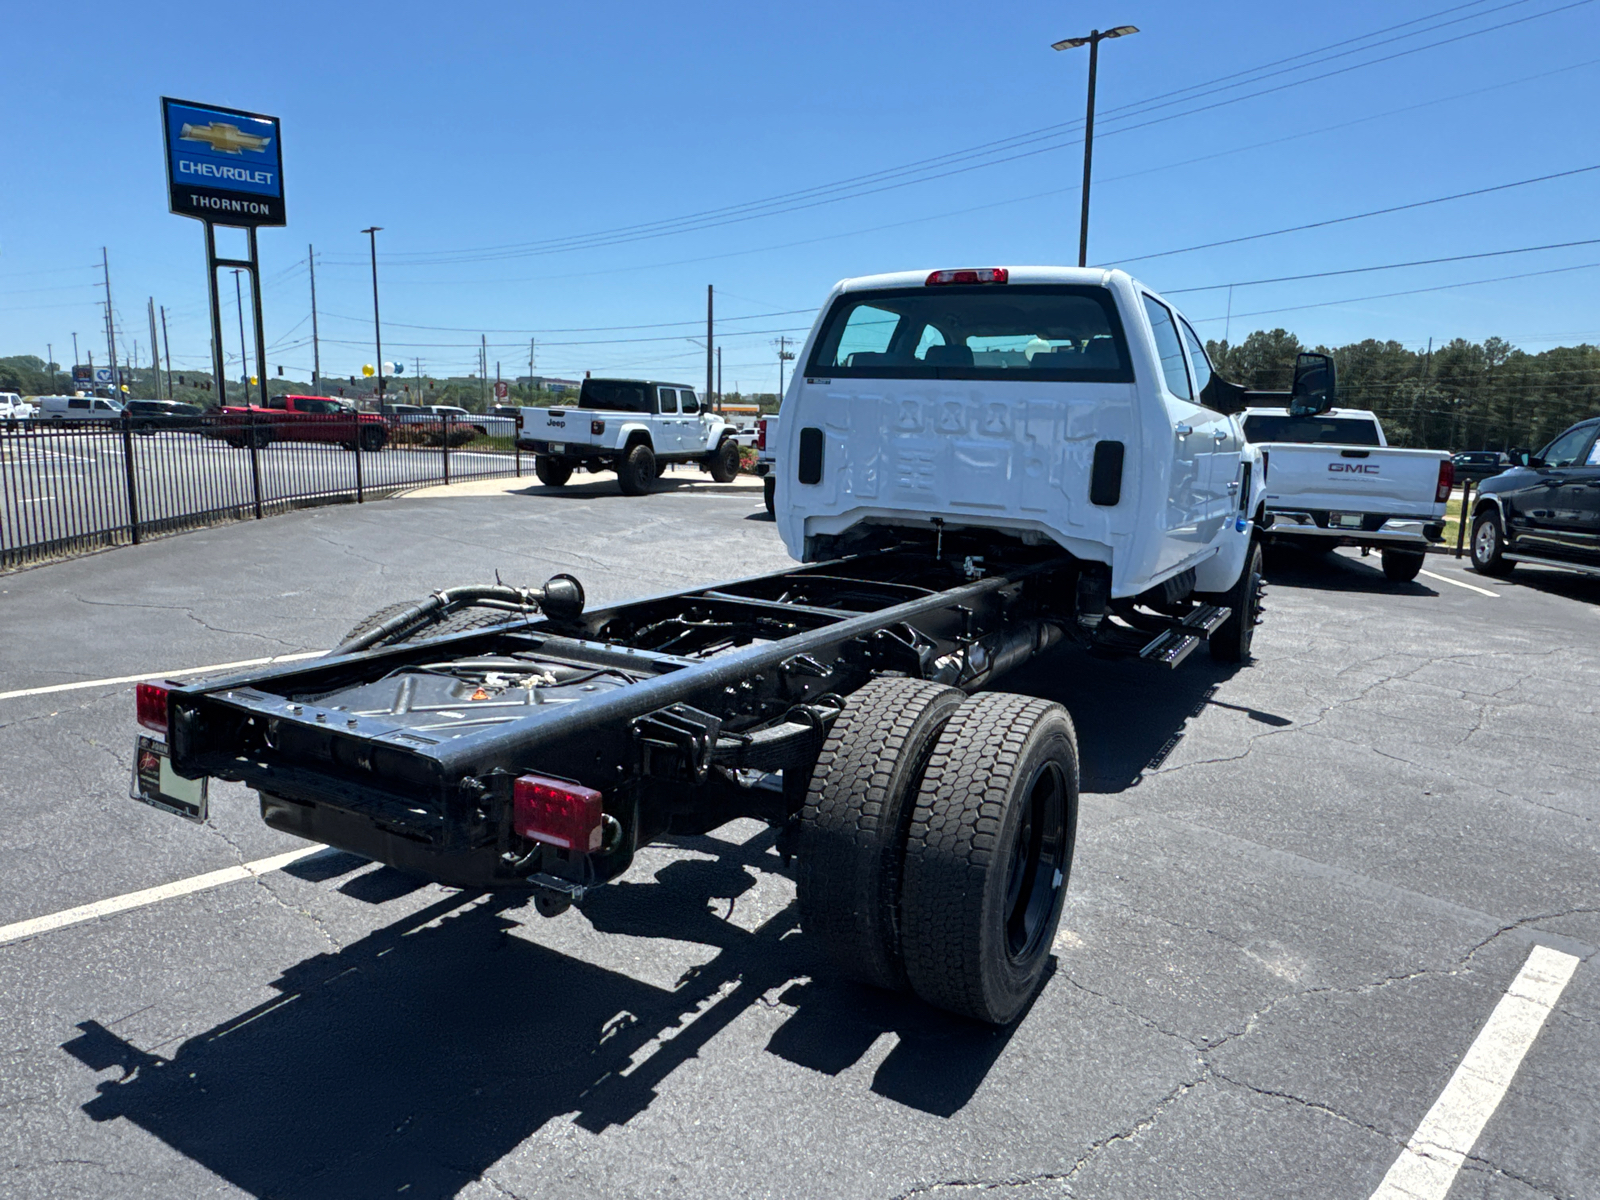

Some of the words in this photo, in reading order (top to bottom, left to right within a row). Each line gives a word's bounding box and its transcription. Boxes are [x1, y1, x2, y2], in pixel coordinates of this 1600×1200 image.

[179, 160, 274, 185] CHEVROLET
[190, 194, 270, 215] THORNTON
[547, 419, 566, 429] Jeep
[1328, 463, 1380, 474] GMC
